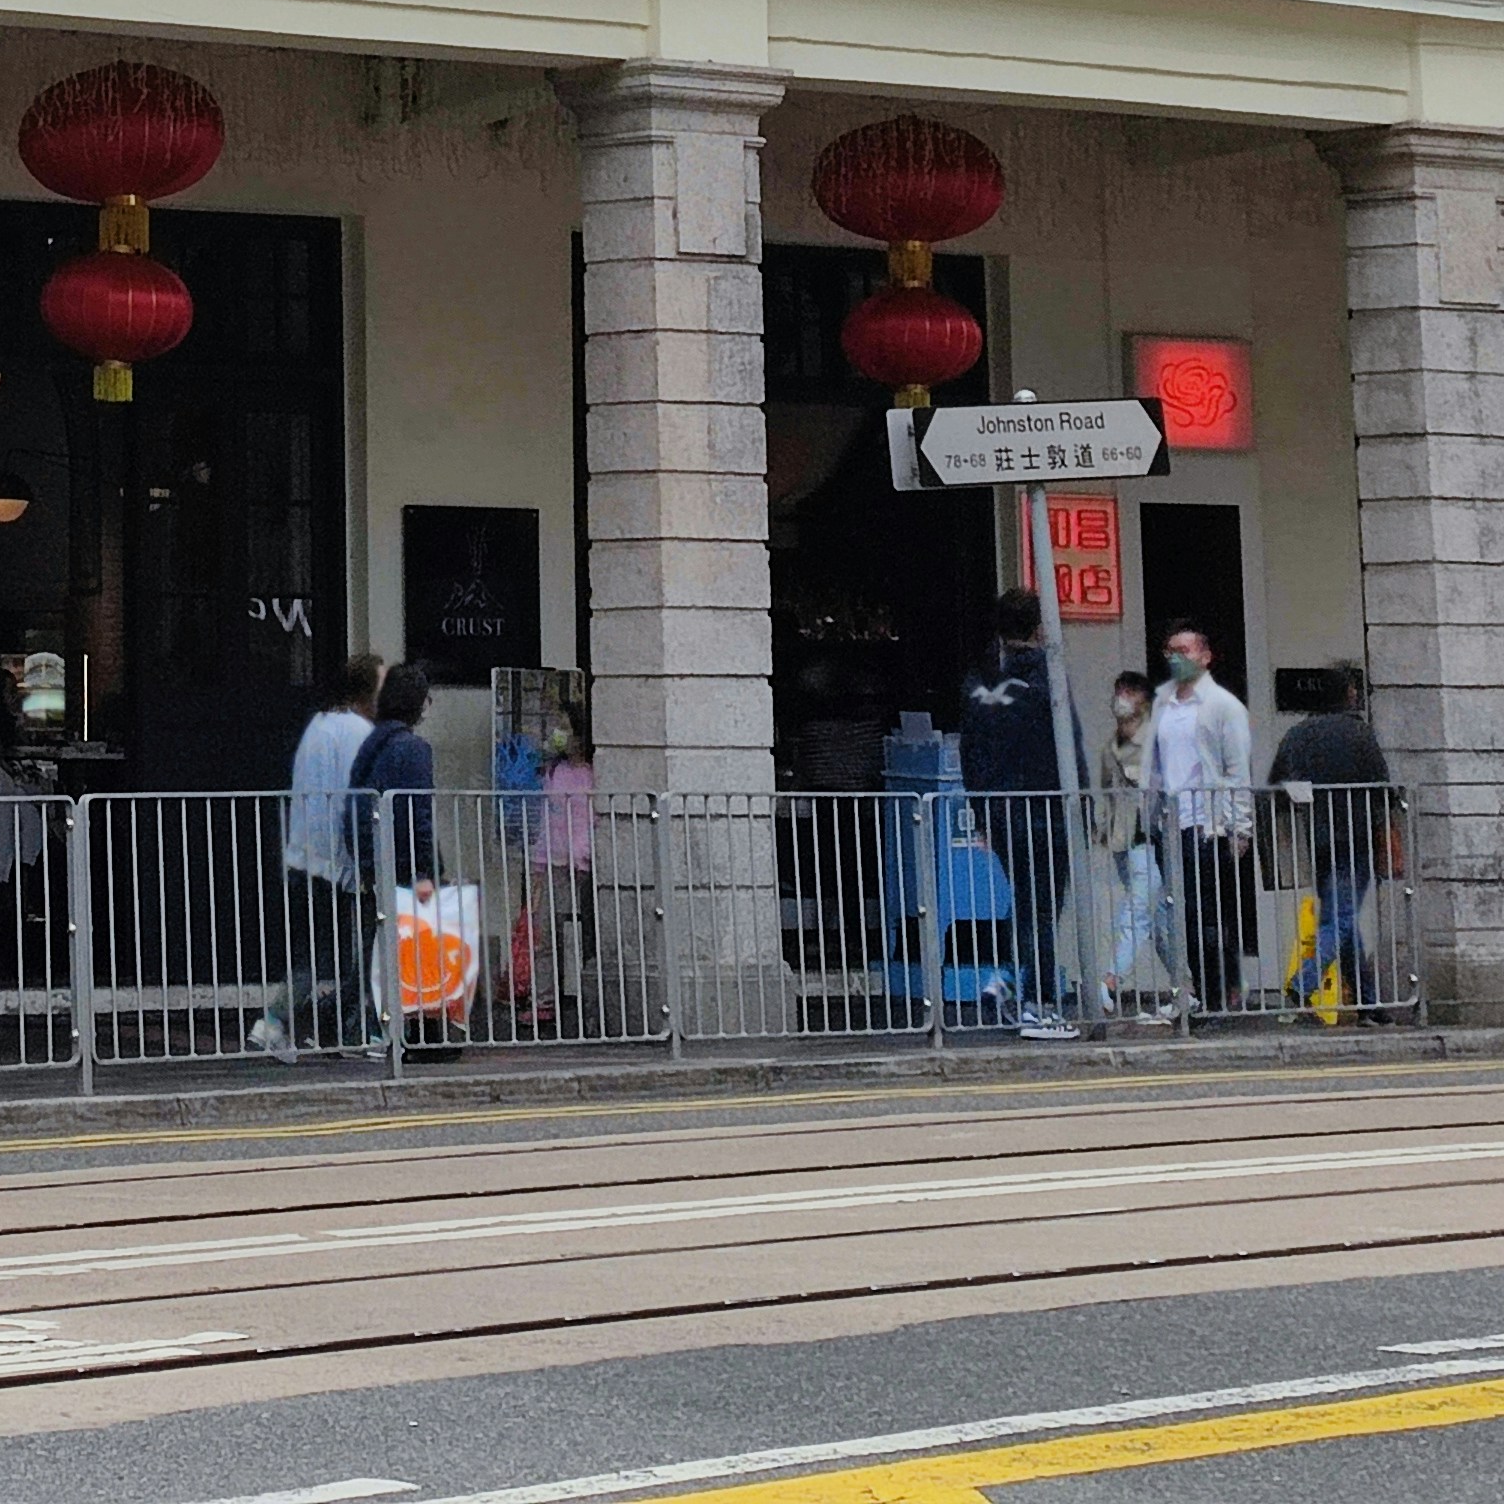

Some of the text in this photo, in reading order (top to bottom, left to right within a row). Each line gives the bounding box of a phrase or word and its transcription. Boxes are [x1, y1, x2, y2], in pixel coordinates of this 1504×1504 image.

[976, 411, 1106, 435] Johnston Road
[993, 443, 1096, 472] 莊士敦道
[441, 617, 506, 637] CRUST
